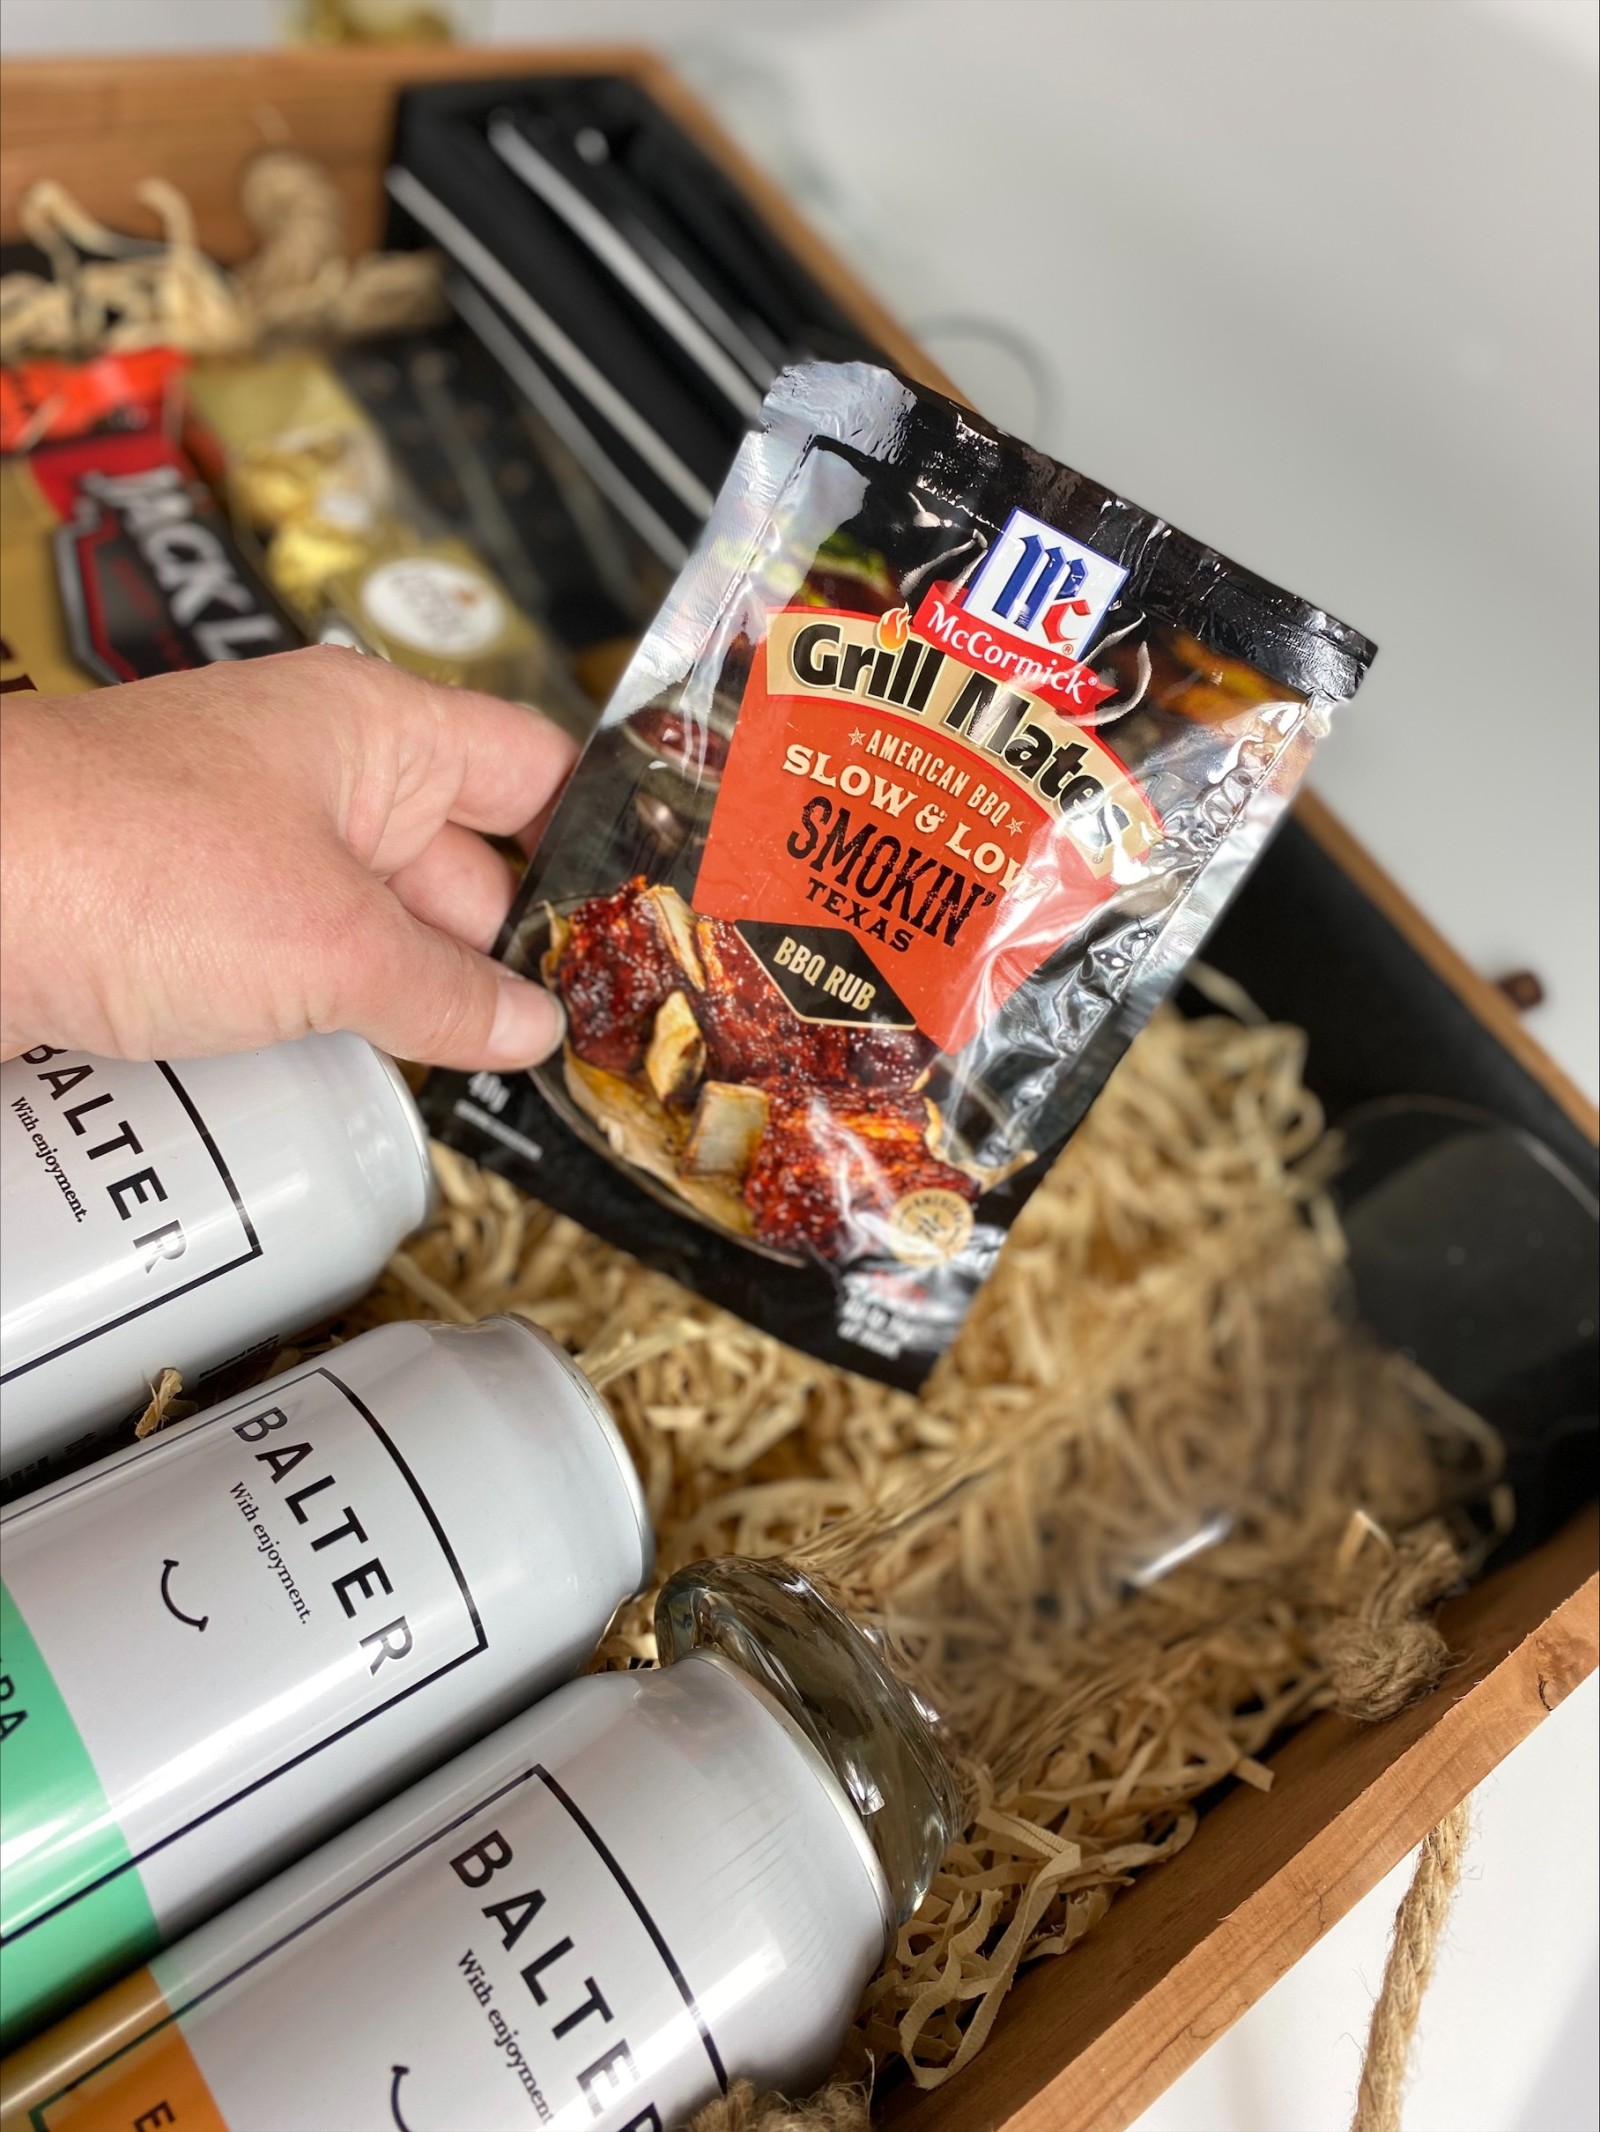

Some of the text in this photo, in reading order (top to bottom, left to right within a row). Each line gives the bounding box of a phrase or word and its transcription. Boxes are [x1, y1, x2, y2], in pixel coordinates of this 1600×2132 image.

[791, 621, 947, 715] Grill
[781, 743, 919, 819] SLOW
[914, 802, 948, 834] &
[865, 729, 1012, 829] AMERICAN BBQ
[786, 795, 998, 947] SMOKIN'
[805, 876, 915, 953] TEXAS
[772, 935, 877, 1011] BBQ RUB
[10, 1096, 88, 1223] With enjoyment.
[229, 1481, 312, 1625] With enjoyment.
[231, 1406, 414, 1677] BALTER
[457, 1948, 494, 2008] With
